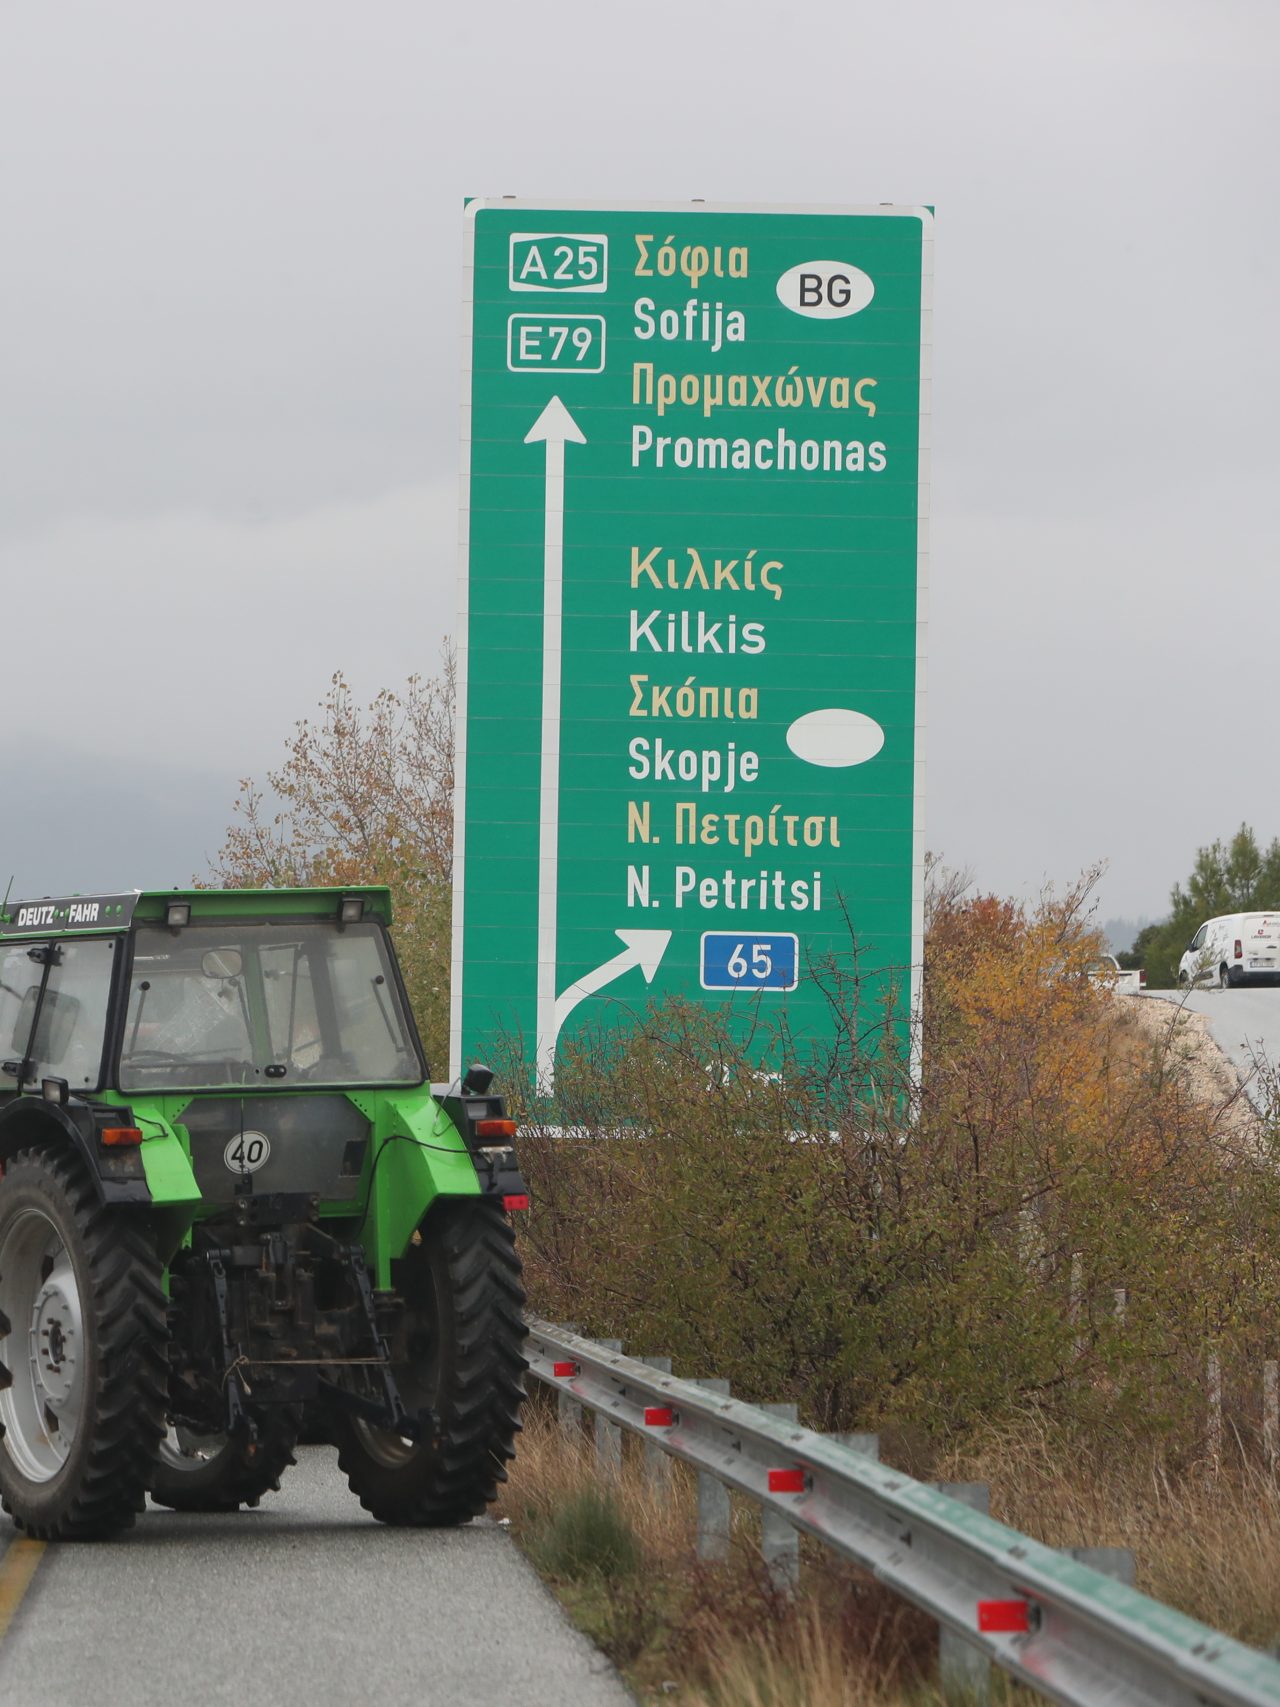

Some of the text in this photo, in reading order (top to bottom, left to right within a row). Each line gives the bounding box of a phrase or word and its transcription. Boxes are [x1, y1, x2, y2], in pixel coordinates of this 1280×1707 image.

[520, 245, 598, 281] A25
[634, 234, 749, 289] Σόφια
[799, 273, 851, 308] BG
[519, 325, 593, 361] E79
[633, 296, 746, 353] Sofija
[632, 362, 878, 418] Προμαχώνας
[631, 424, 887, 472] Promachonas
[630, 546, 784, 601] Κιλκίς
[629, 609, 766, 655] Kilkis
[629, 674, 758, 720] Σκόπια
[628, 736, 759, 793] Skopje
[627, 800, 841, 858] Ν. Πετρίτσι
[627, 864, 821, 911] N. Petritsi
[17, 905, 56, 927] DEUTZ
[68, 902, 100, 923] FAHR
[727, 943, 773, 979] 65
[231, 1140, 264, 1163] 40
